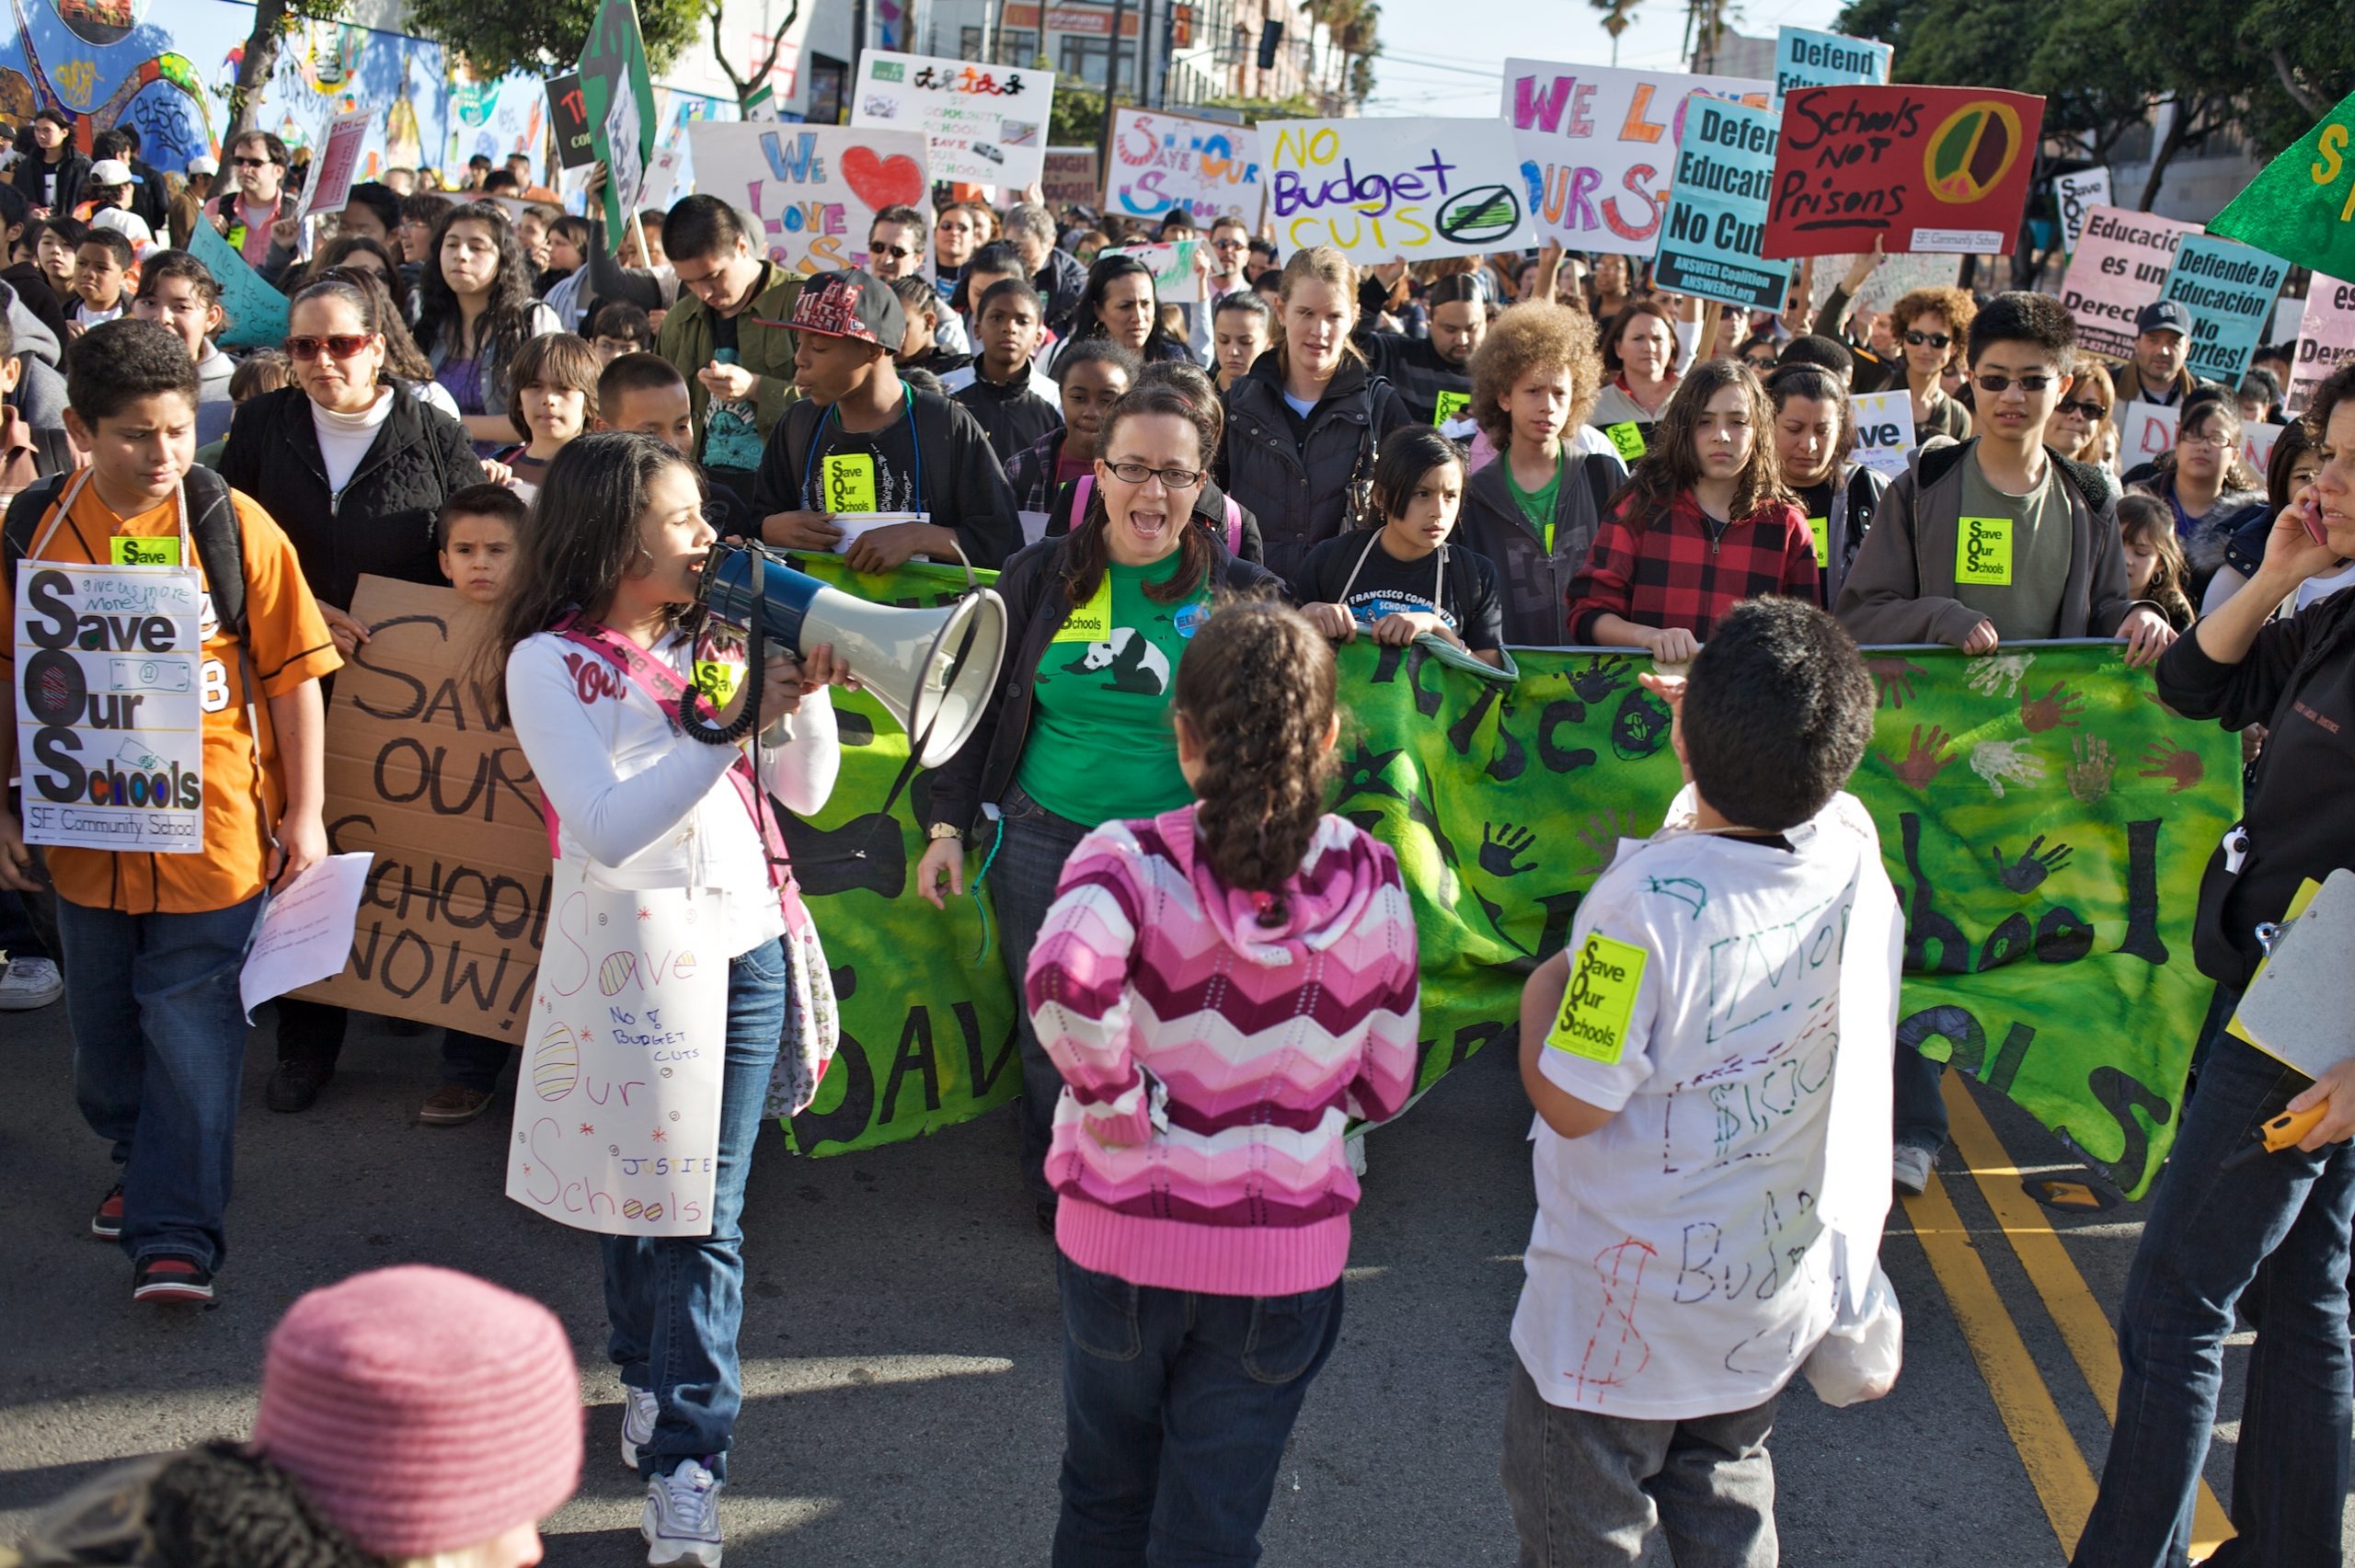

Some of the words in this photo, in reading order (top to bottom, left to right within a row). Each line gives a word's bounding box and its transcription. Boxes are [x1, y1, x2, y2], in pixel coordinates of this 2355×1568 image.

[1790, 37, 1874, 76] Defend
[1514, 75, 1597, 137] WE
[1788, 90, 1924, 151] Schools
[1272, 127, 1339, 169] NO
[1700, 109, 1780, 157] Defen
[1816, 138, 1891, 169] NOT
[759, 131, 827, 183] WE
[1200, 133, 1259, 185] OUR
[1678, 150, 1775, 202] Educati
[1274, 148, 1456, 218] Budget
[1774, 170, 1907, 223] Prisons
[2062, 178, 2102, 200] Save
[747, 179, 848, 235] LOVE
[1289, 202, 1432, 249] CUTS
[1669, 201, 1708, 245] No
[1714, 212, 1766, 258] Cut
[1673, 256, 1720, 278] ANSWER
[1720, 266, 1770, 289] Coalition
[2100, 256, 2129, 276] es
[2177, 248, 2259, 284] Defiende
[2260, 265, 2280, 290] la
[2167, 278, 2268, 317] Educación
[2191, 317, 2221, 341] No
[2185, 340, 2249, 372] ortes!
[832, 461, 862, 478] Save
[833, 477, 856, 497] Our
[834, 496, 870, 514] Schools
[122, 540, 167, 564] Save
[1967, 538, 1994, 557] Our
[1969, 521, 2003, 541] Save
[1966, 555, 2005, 574] Schools
[26, 570, 177, 654] Save
[83, 579, 114, 592] give
[118, 582, 138, 598] us
[144, 586, 191, 604] more
[1349, 589, 1404, 606] FRANCISCO
[1404, 592, 1458, 628] COMMNITY
[1379, 601, 1411, 613] SCHOOL
[23, 648, 144, 730] Our
[352, 614, 512, 732] SAV
[700, 664, 735, 693] Sav
[32, 725, 201, 811] Schools
[373, 737, 547, 822] OUR
[29, 807, 54, 829] SF
[61, 810, 143, 842] Community
[148, 815, 196, 837] School
[551, 890, 697, 996] Save
[1581, 940, 1626, 983] Save
[1570, 970, 1605, 1009] Our
[613, 1029, 685, 1046] BUDGET
[1560, 1000, 1616, 1047] Schools
[533, 1021, 647, 1107] Our
[654, 1047, 701, 1063] CUTS
[789, 962, 1022, 1144] SAV
[526, 1116, 702, 1223] Schools
